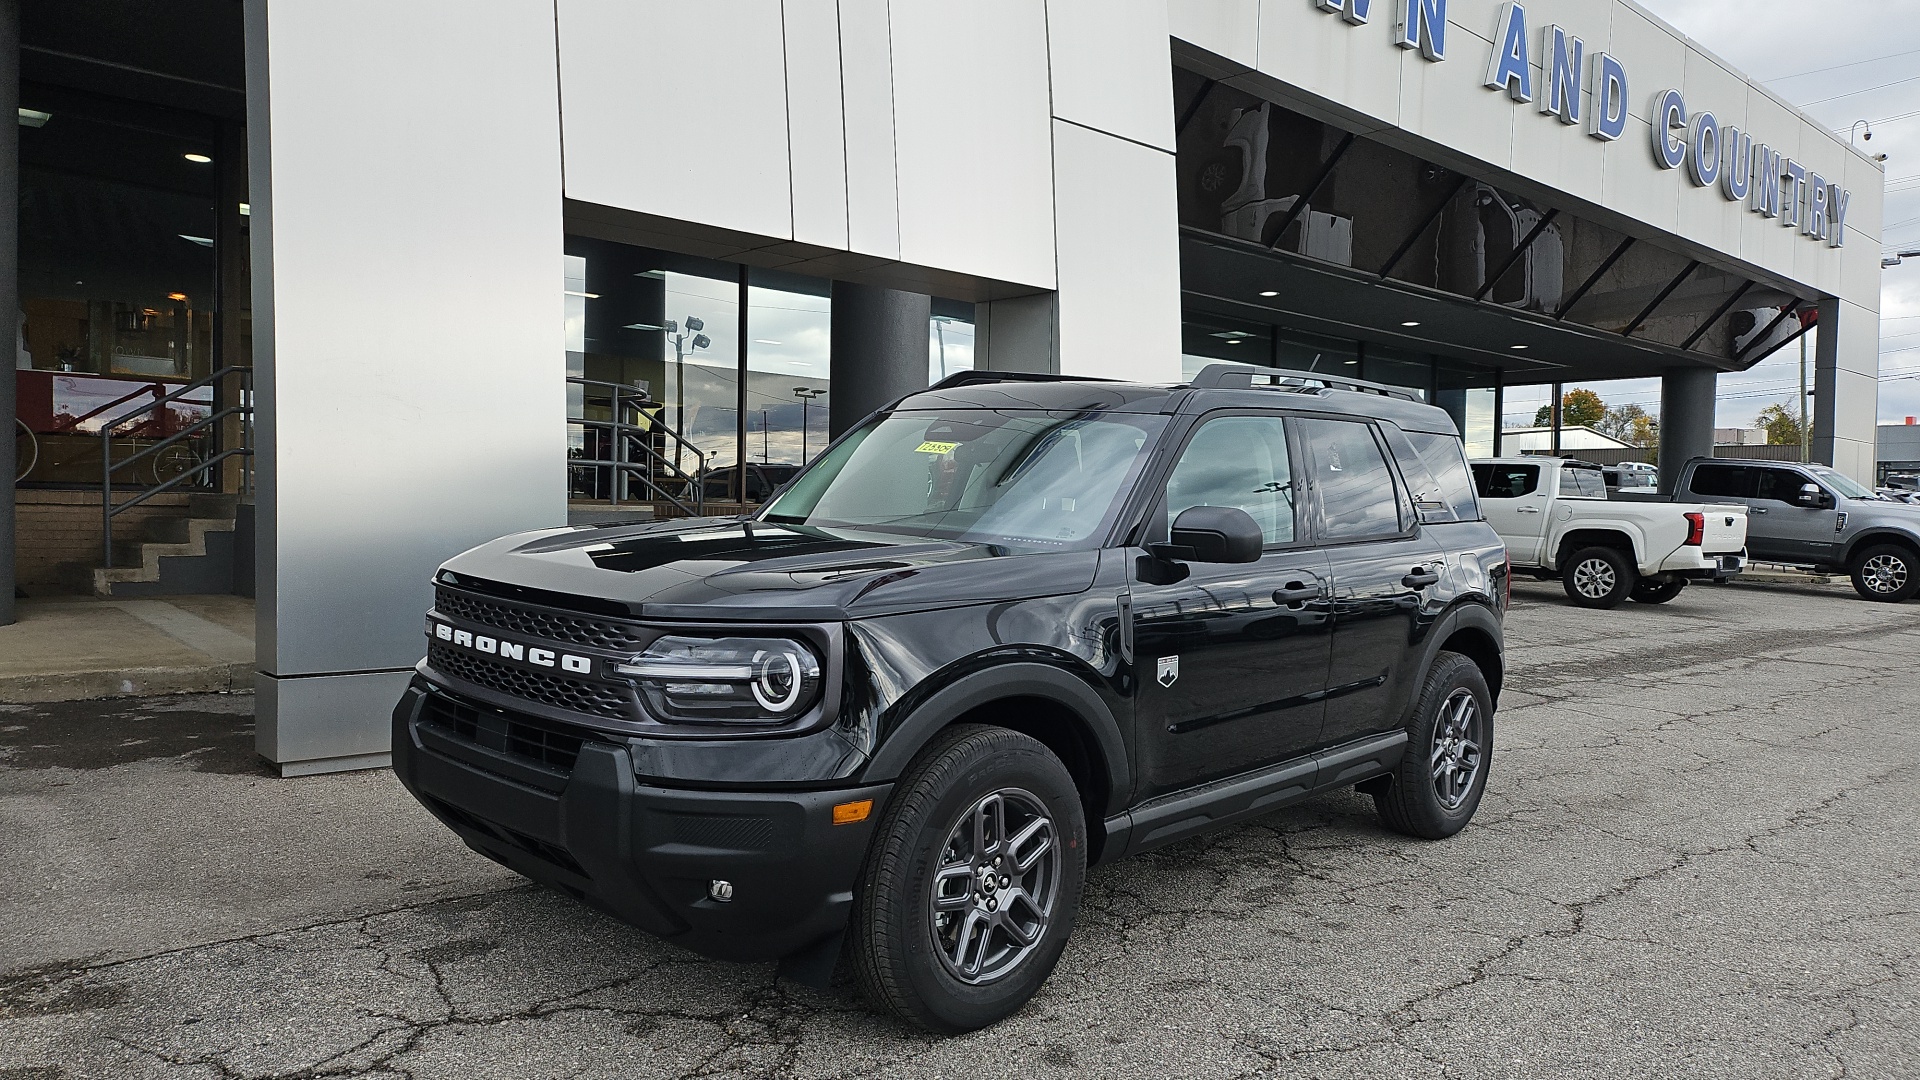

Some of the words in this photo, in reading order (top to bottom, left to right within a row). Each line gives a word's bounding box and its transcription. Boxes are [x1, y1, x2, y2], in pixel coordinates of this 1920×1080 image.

[1316, 0, 1448, 62] N
[1484, 2, 1629, 142] AND
[1651, 88, 1851, 248] COUNTRY
[436, 623, 591, 674] BRONCO
